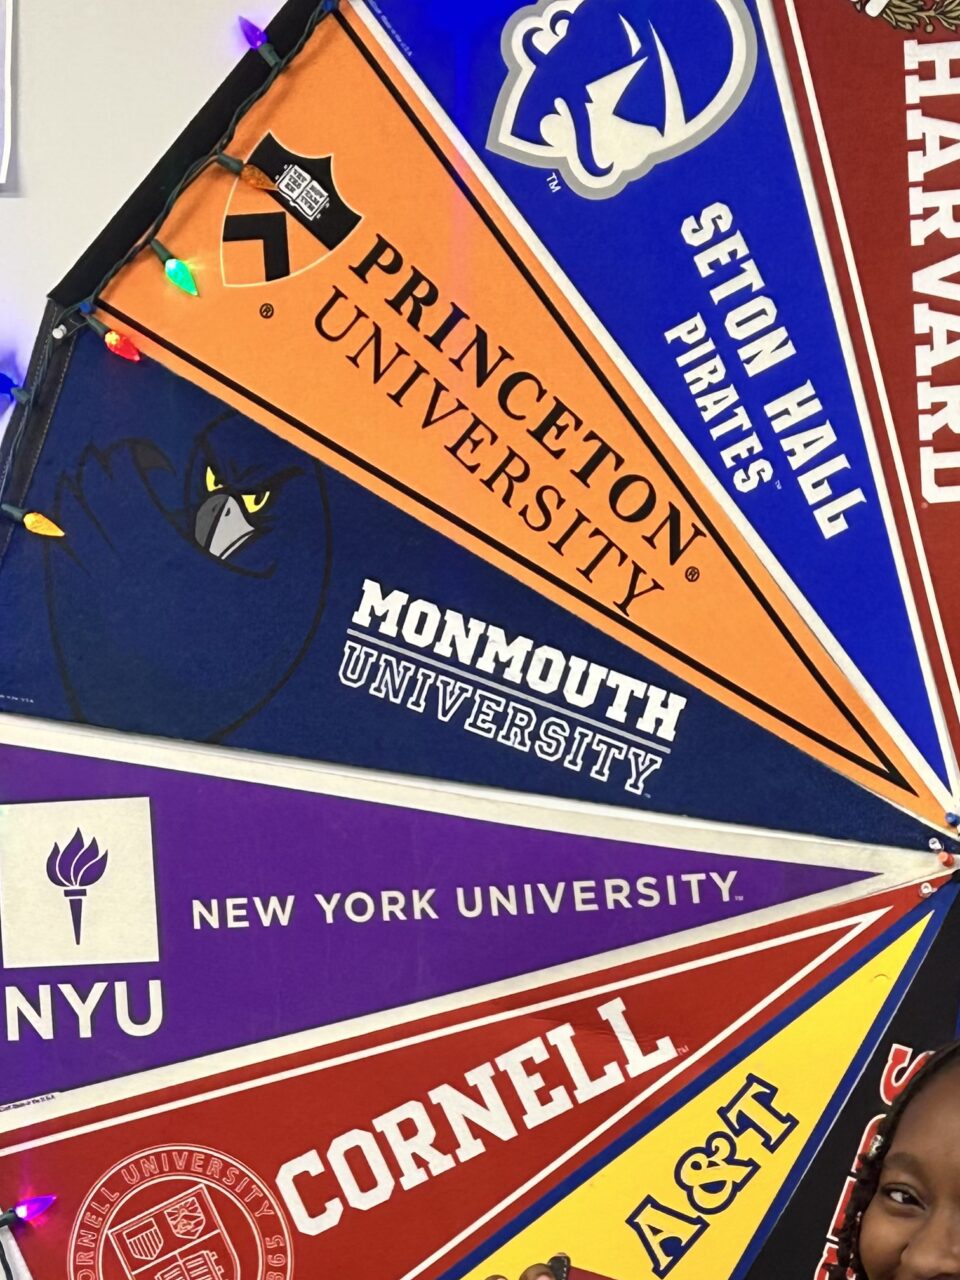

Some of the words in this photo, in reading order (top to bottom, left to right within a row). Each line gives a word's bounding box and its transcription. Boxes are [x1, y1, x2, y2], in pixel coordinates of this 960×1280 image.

[313, 287, 665, 617] UNIVERSITY
[349, 234, 707, 565] PRINCETON
[664, 313, 773, 494] PIRATES
[680, 202, 796, 377] SETON
[765, 380, 866, 540] HALL
[338, 641, 662, 796] UNIVERSITY
[351, 578, 687, 741] MONMOUTH
[192, 894, 296, 930] NEW
[315, 888, 439, 924] YORK
[456, 870, 738, 919] UNIVERSITY
[4, 979, 164, 1041] NYU
[121, 1151, 275, 1217] UNIVERSITY
[275, 997, 678, 1237] CORNELL
[626, 1073, 799, 1279] A&T
